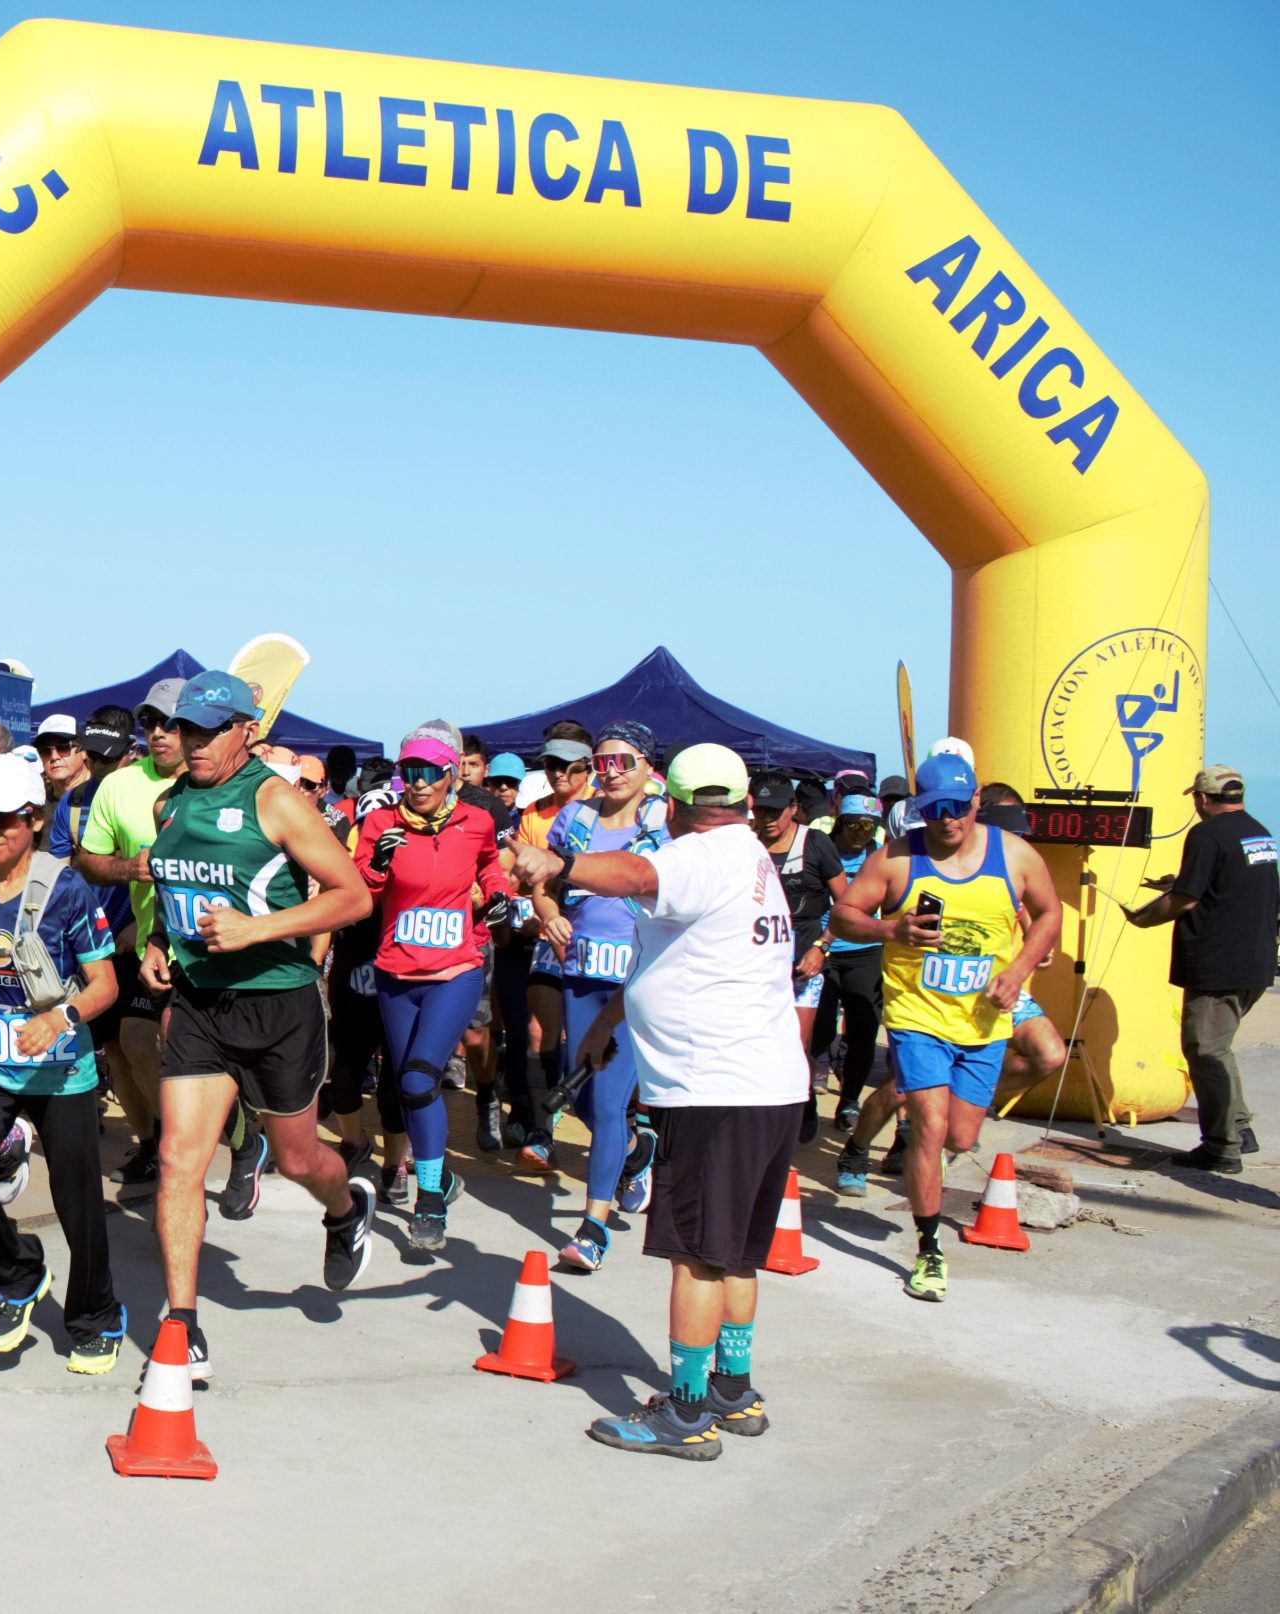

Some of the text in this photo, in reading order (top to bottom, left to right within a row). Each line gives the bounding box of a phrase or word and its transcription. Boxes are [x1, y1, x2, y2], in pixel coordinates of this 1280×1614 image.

[198, 80, 791, 222] ATLETICA DE
[905, 235, 1120, 475] ARICA
[1050, 665, 1090, 791] SOCIACIÓN
[1094, 632, 1186, 666] ATLÉTICA
[150, 858, 235, 885] GENCHI
[397, 909, 463, 946] 0609
[752, 914, 792, 946] STA
[576, 938, 633, 979] 0300
[923, 955, 994, 993] 0158
